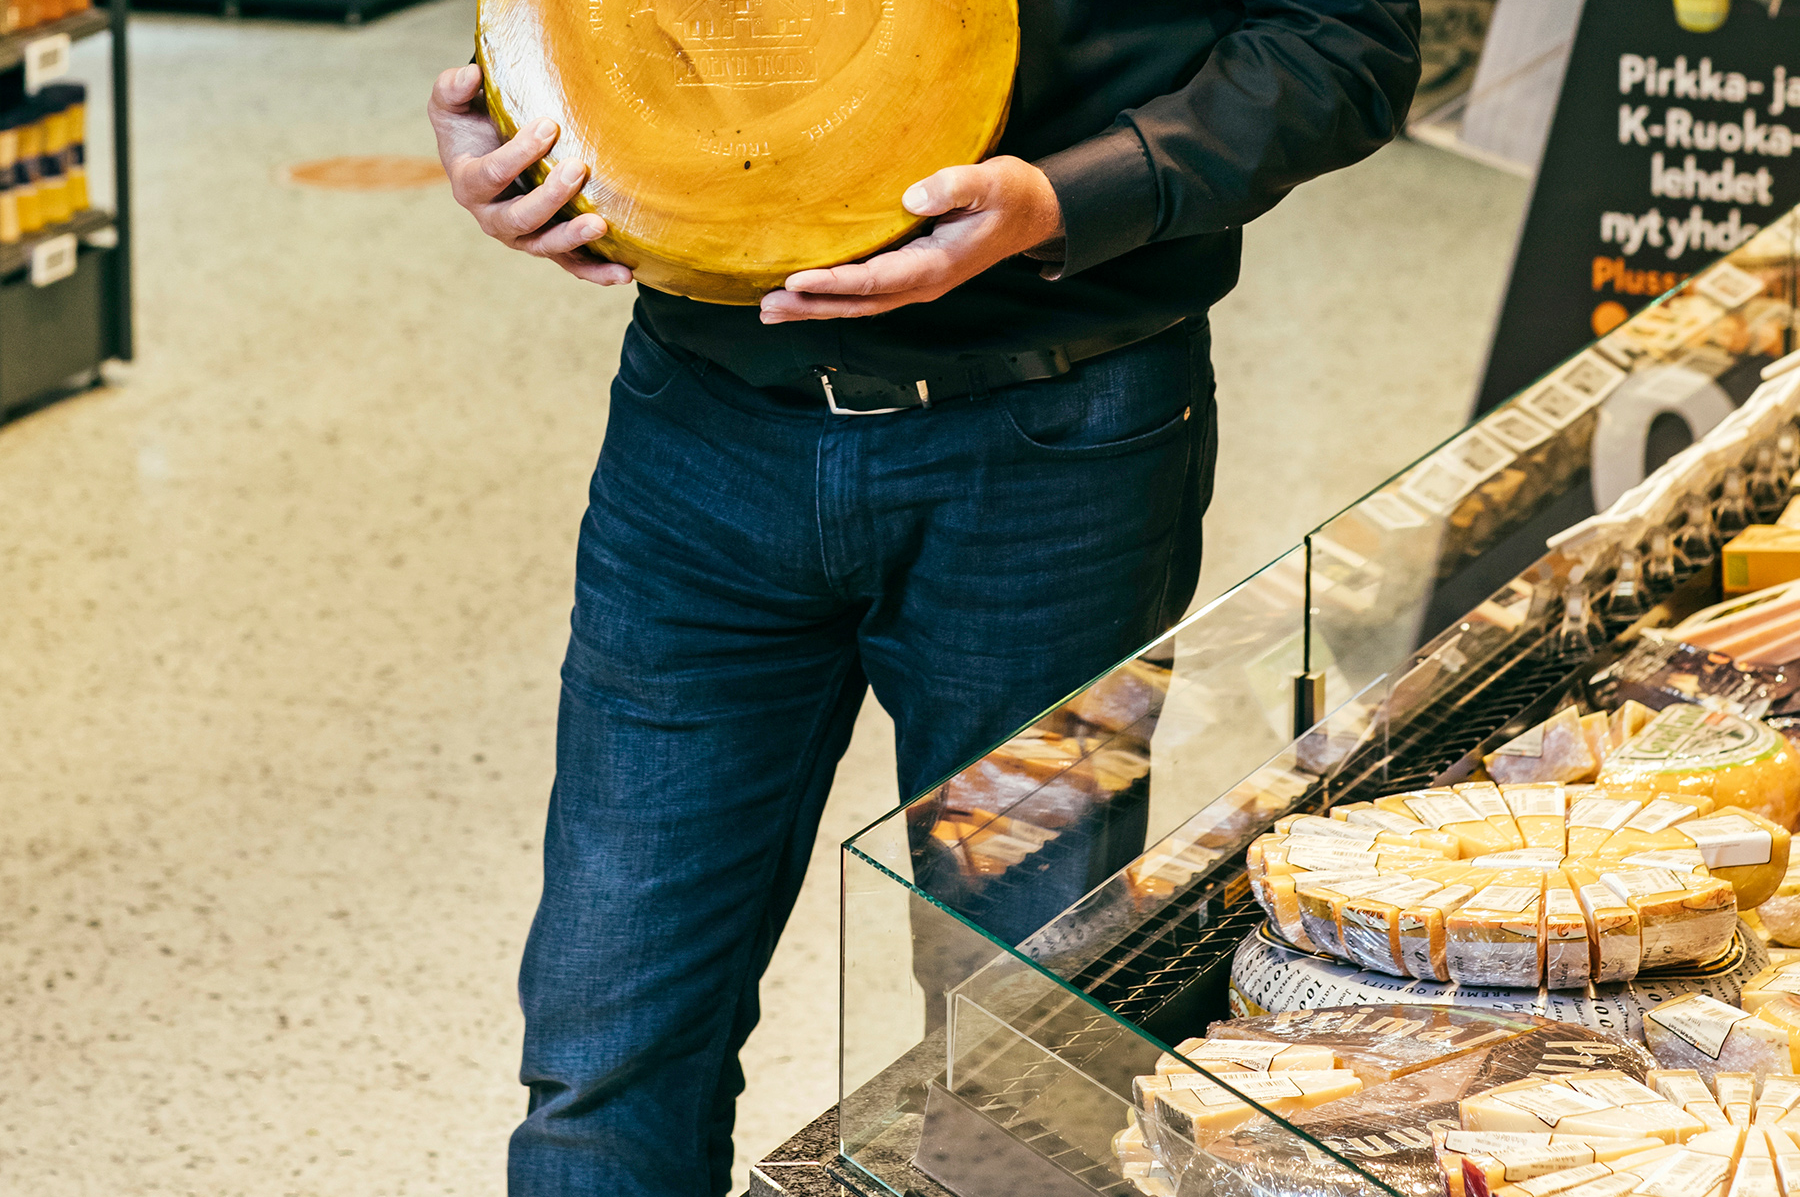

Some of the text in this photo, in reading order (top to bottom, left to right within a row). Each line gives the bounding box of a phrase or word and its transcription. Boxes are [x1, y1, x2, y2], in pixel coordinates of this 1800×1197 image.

[1618, 52, 1766, 104] Pirkka-
[1618, 103, 1800, 157] K-Ruoka-
[1650, 152, 1774, 204] lehdet
[1600, 208, 1664, 256] nyt
[1591, 256, 1690, 295] Pluss
[1298, 979, 1324, 1011] 100
[1360, 978, 1512, 999] PREMIUM QUALITY
[1589, 996, 1615, 1030] 100
